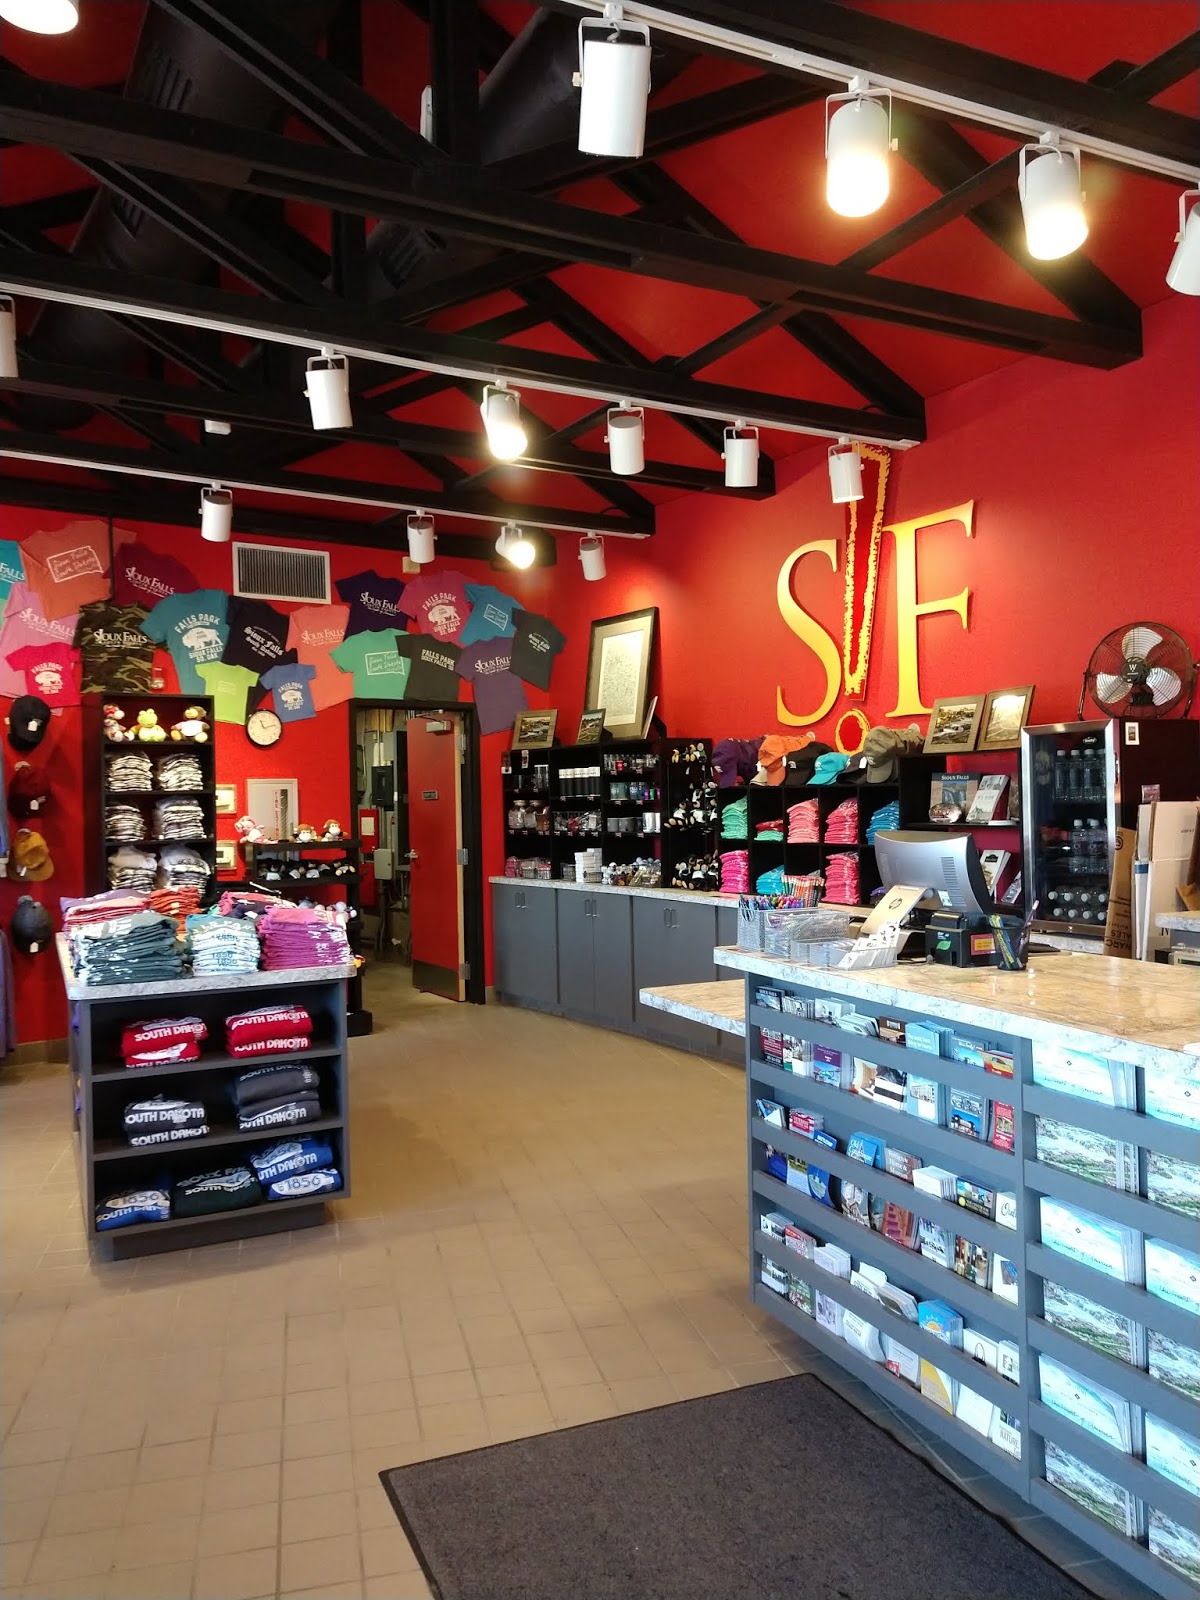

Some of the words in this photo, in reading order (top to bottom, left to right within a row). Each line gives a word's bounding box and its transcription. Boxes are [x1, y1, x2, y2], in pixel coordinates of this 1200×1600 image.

[125, 567, 152, 587] SIOUX
[150, 578, 175, 595] FALLS
[360, 592, 382, 606] SIOUX
[422, 594, 439, 611] FALLS
[439, 592, 457, 603] PARK
[19, 607, 49, 627] SIOUX
[50, 619, 75, 638] FALLS
[175, 615, 199, 634] FALLS
[198, 613, 221, 626] PARK
[94, 628, 122, 643] SIOUX
[122, 631, 148, 643] FALLS
[244, 626, 265, 644] Sioux
[265, 638, 284, 656] Falls
[301, 630, 324, 644] SIOUX
[324, 629, 345, 638] FALLS
[189, 650, 206, 659] SIOUX
[206, 646, 223, 656] FALLS
[421, 649, 440, 661] FALLS
[439, 654, 455, 667] PARK
[474, 659, 496, 673] SIOUX
[494, 656, 511, 668] FALL
[266, 1011, 309, 1023] DAKOTA
[134, 1027, 172, 1042] SOUTH
[266, 1037, 309, 1049] DAKOTA
[264, 1107, 307, 1125] DAKOTA
[131, 1131, 169, 1146] SOUTH
[277, 1153, 318, 1174] DAKOTA
[286, 1175, 321, 1191] 1856
